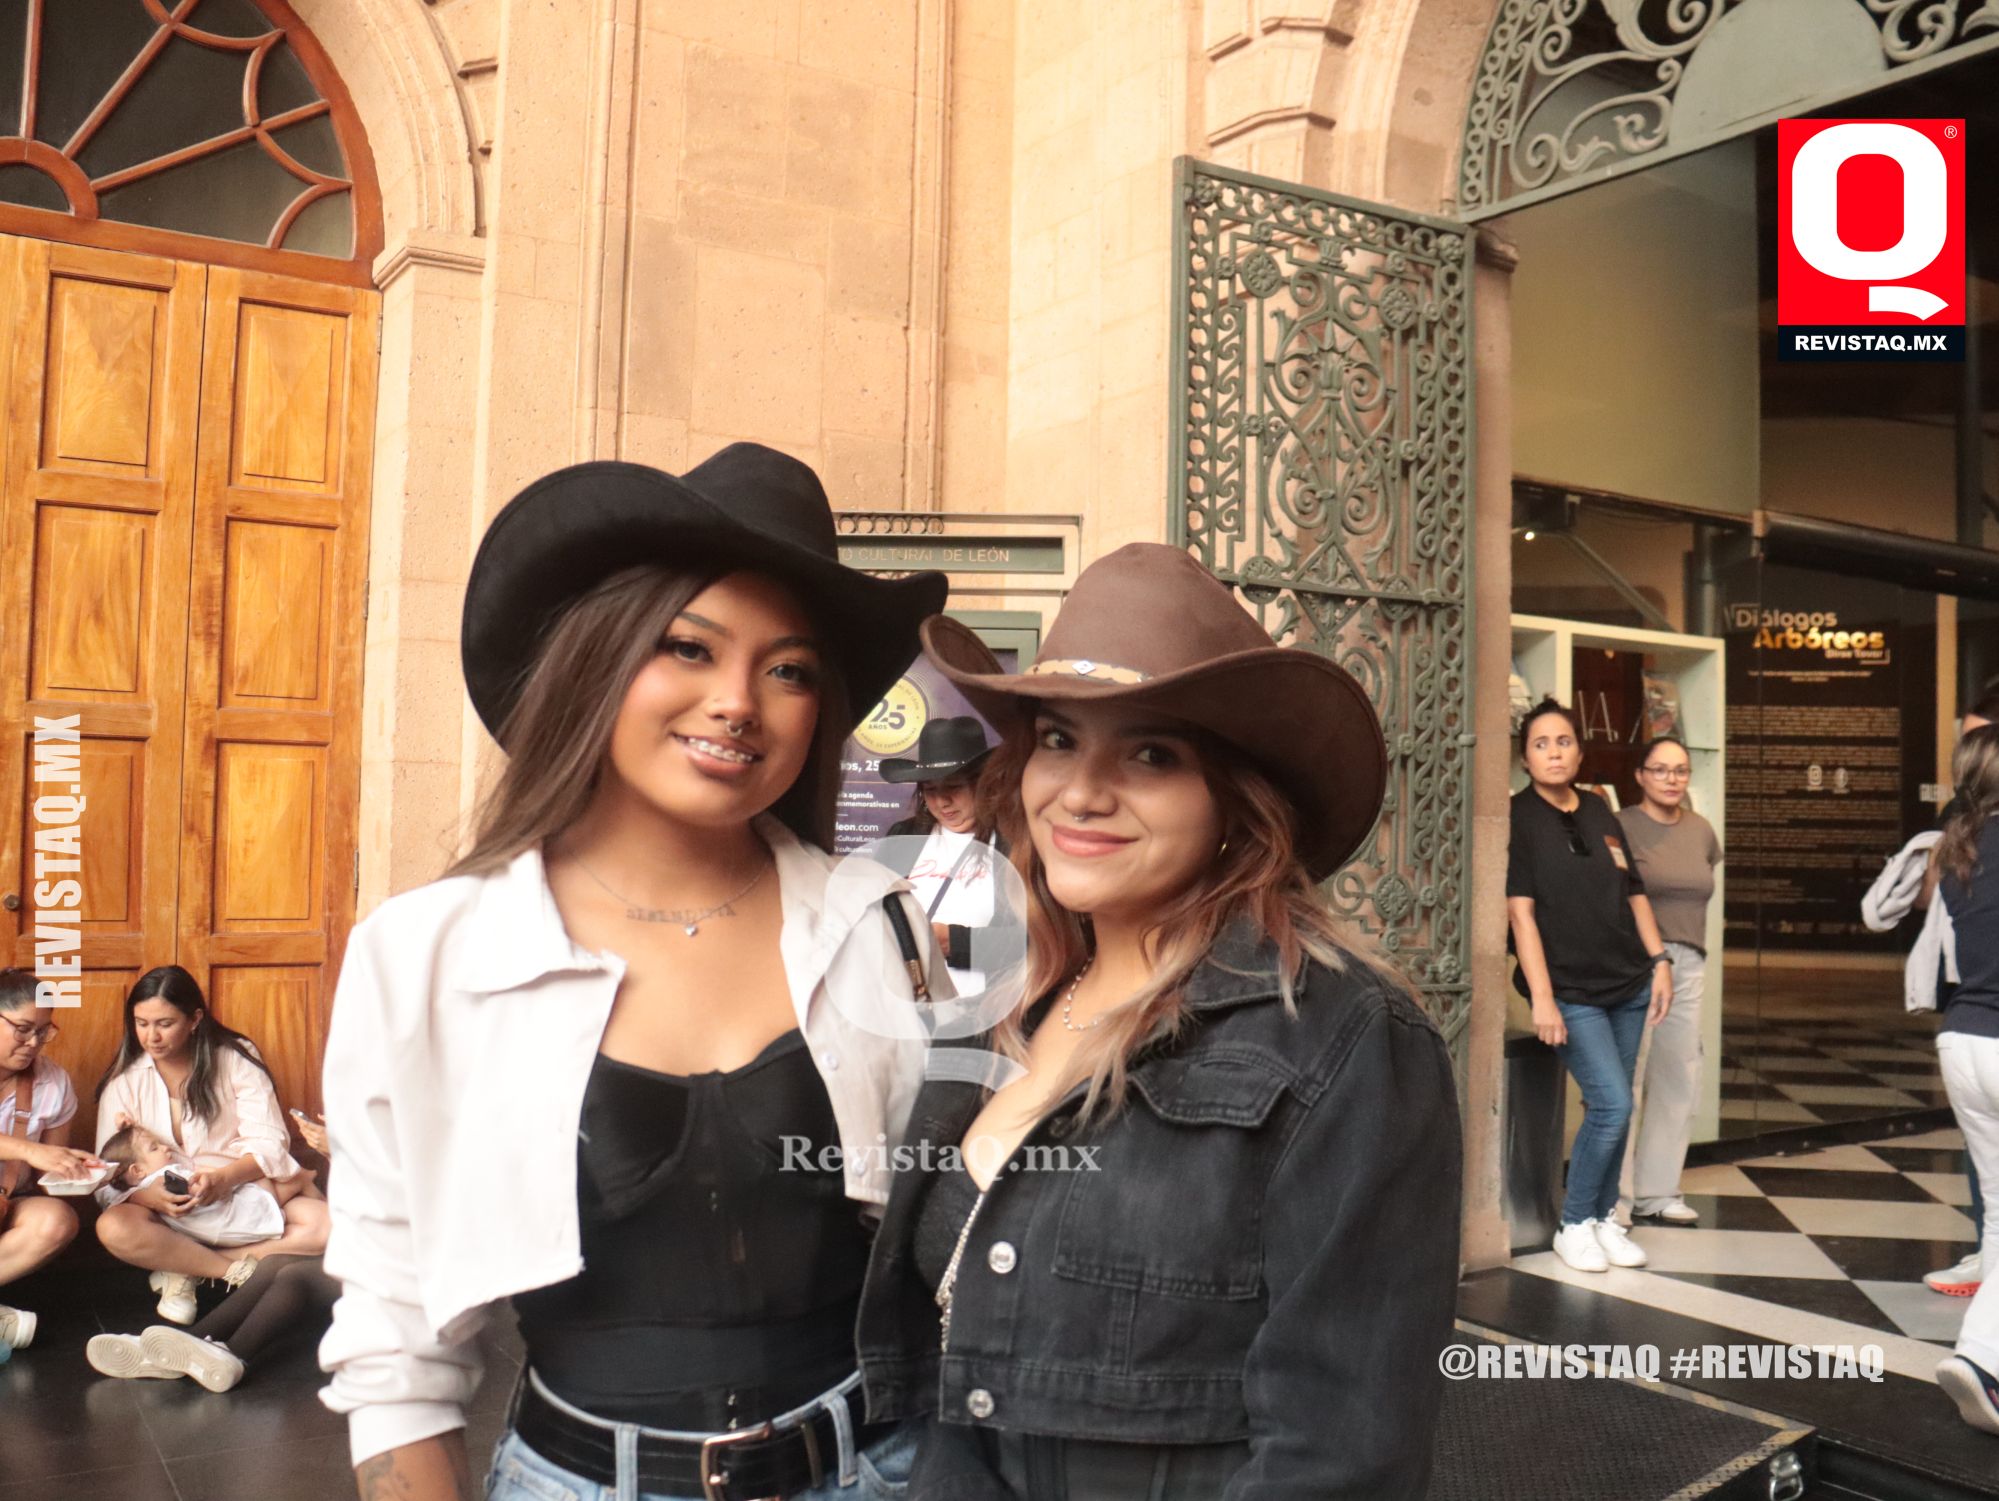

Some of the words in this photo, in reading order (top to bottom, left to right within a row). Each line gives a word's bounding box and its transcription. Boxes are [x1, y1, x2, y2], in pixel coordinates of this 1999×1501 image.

[859, 548, 934, 562] CULTURAL
[943, 548, 963, 562] DE
[968, 546, 1009, 563] LEÓN
[1735, 609, 1838, 631] Diálogos
[1753, 626, 1885, 650] Arbóreos
[869, 699, 906, 730] 25
[865, 760, 880, 772] 25
[848, 791, 874, 800] agenda
